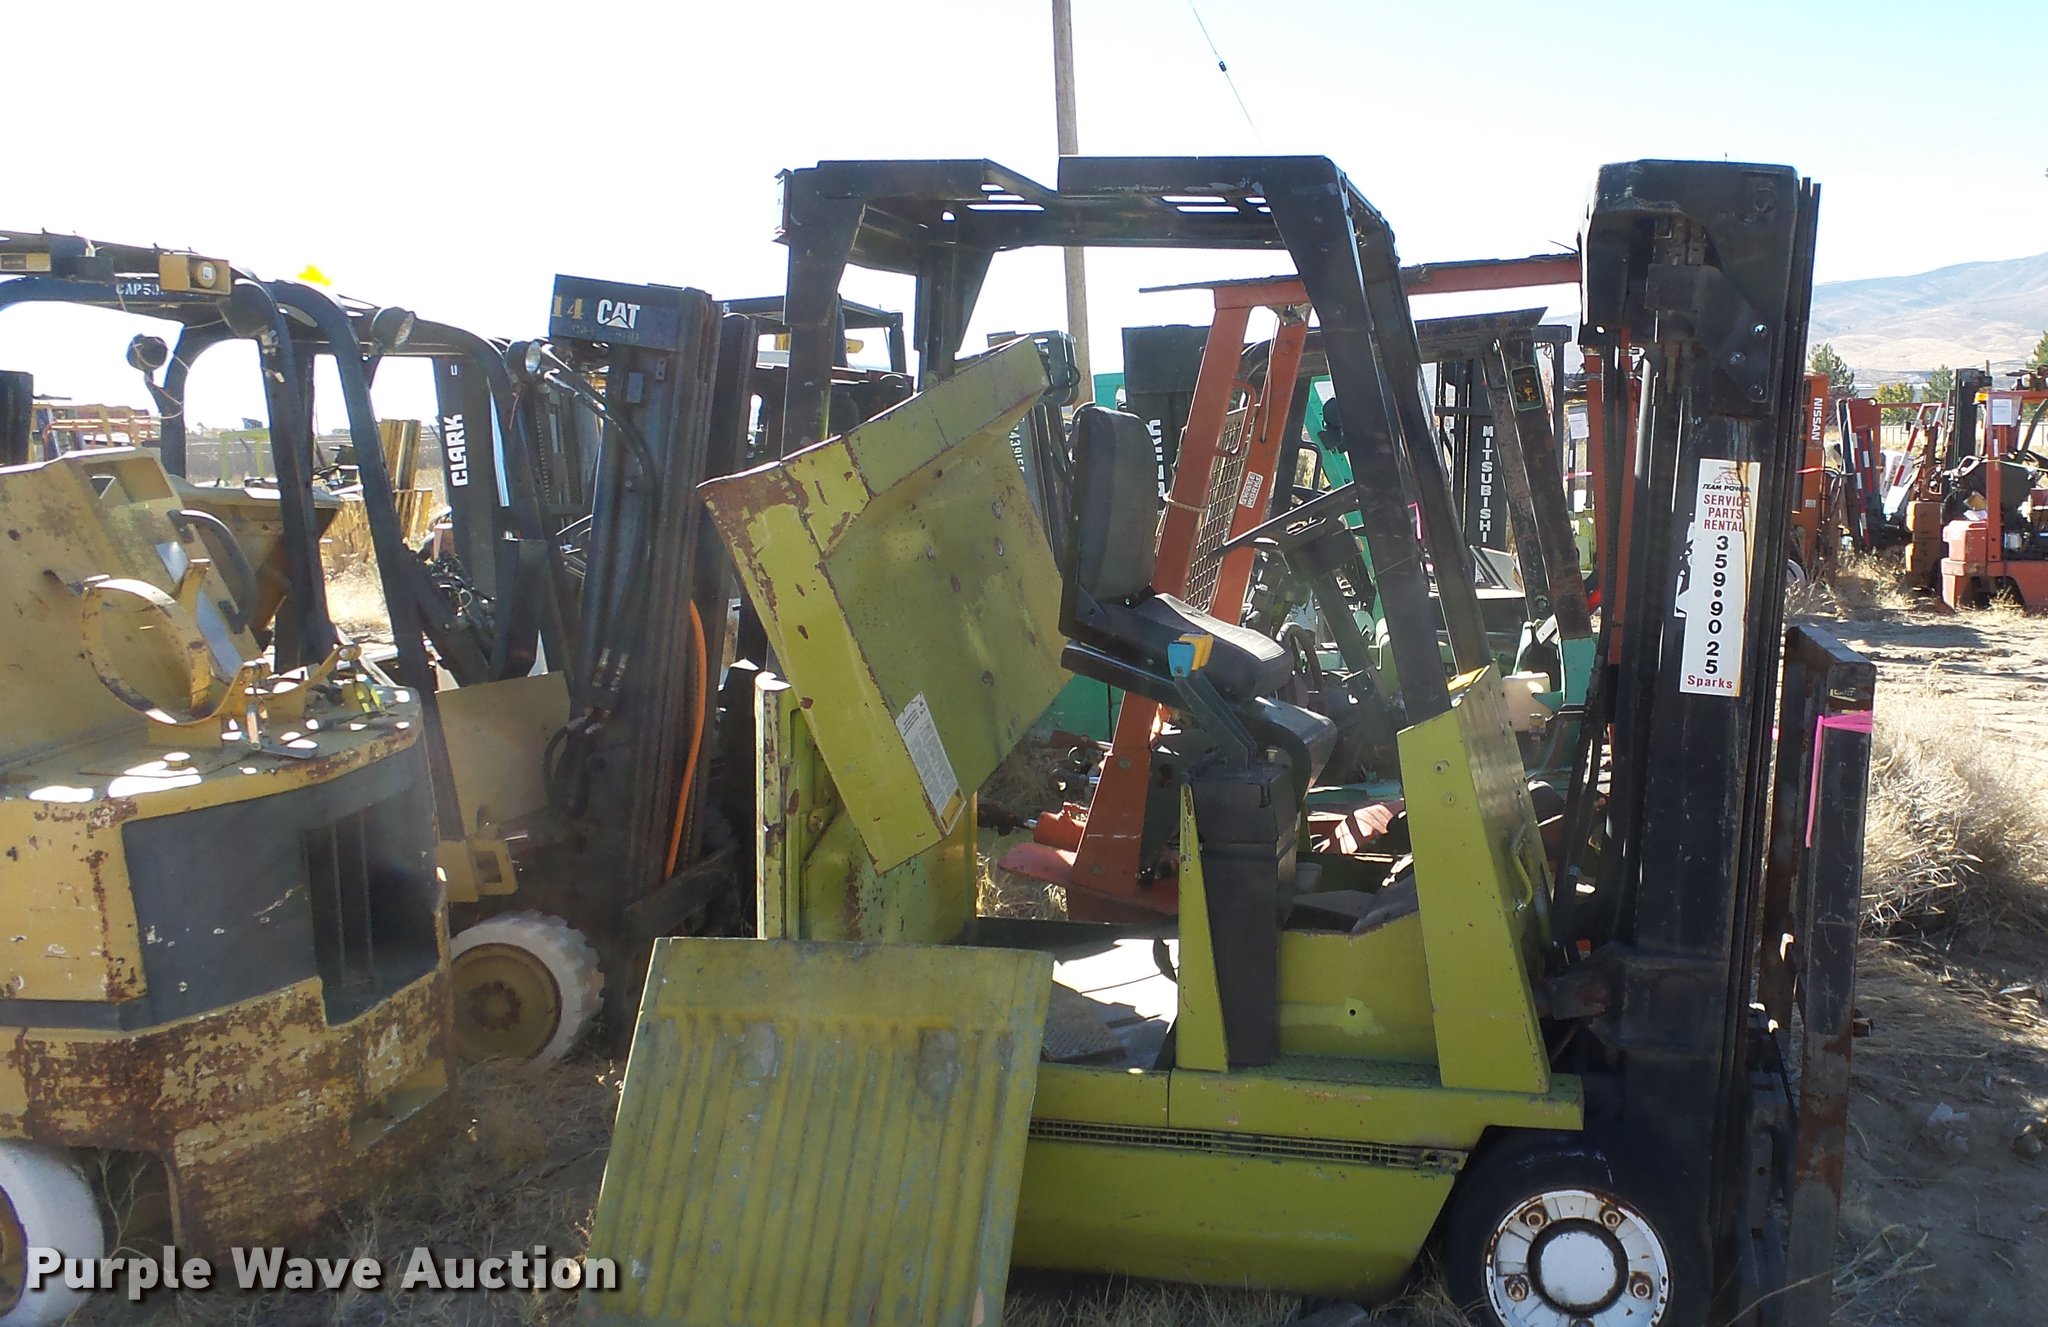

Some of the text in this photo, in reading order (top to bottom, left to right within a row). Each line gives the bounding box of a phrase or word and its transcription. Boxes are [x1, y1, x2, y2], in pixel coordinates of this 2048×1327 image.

[597, 299, 640, 329] CAT
[1811, 397, 1823, 440] NISSAN
[443, 414, 469, 487] CLARK
[1479, 425, 1494, 543] MITSUBISHI
[1724, 485, 1752, 493] POW
[1704, 494, 1750, 507] SERVICE
[1708, 507, 1743, 520] PARTS
[1704, 519, 1744, 532] RENTAL
[1687, 675, 1733, 689] Sparks
